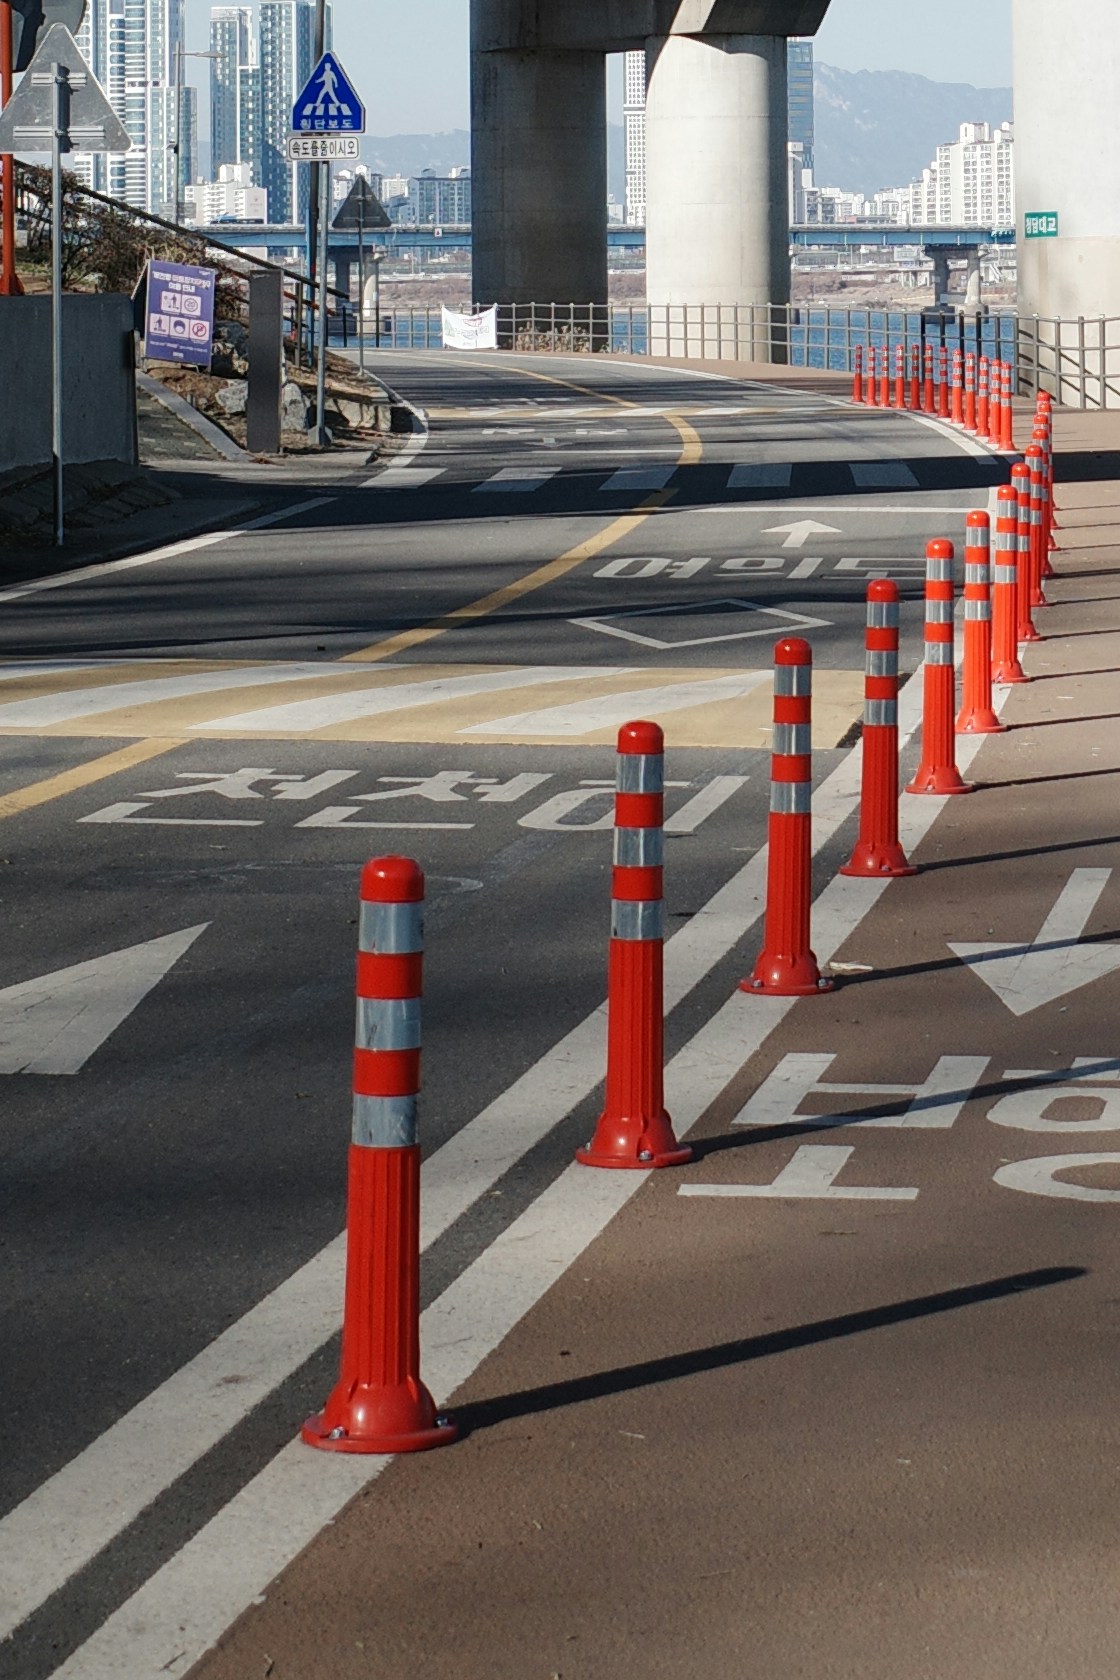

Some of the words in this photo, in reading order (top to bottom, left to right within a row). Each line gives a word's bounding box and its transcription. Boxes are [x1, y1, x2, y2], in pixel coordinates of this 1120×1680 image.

[300, 118, 354, 130] 횡단보도
[1026, 216, 1056, 234] 청담대교
[592, 556, 927, 580] 여의도
[76, 766, 751, 832] 천천히
